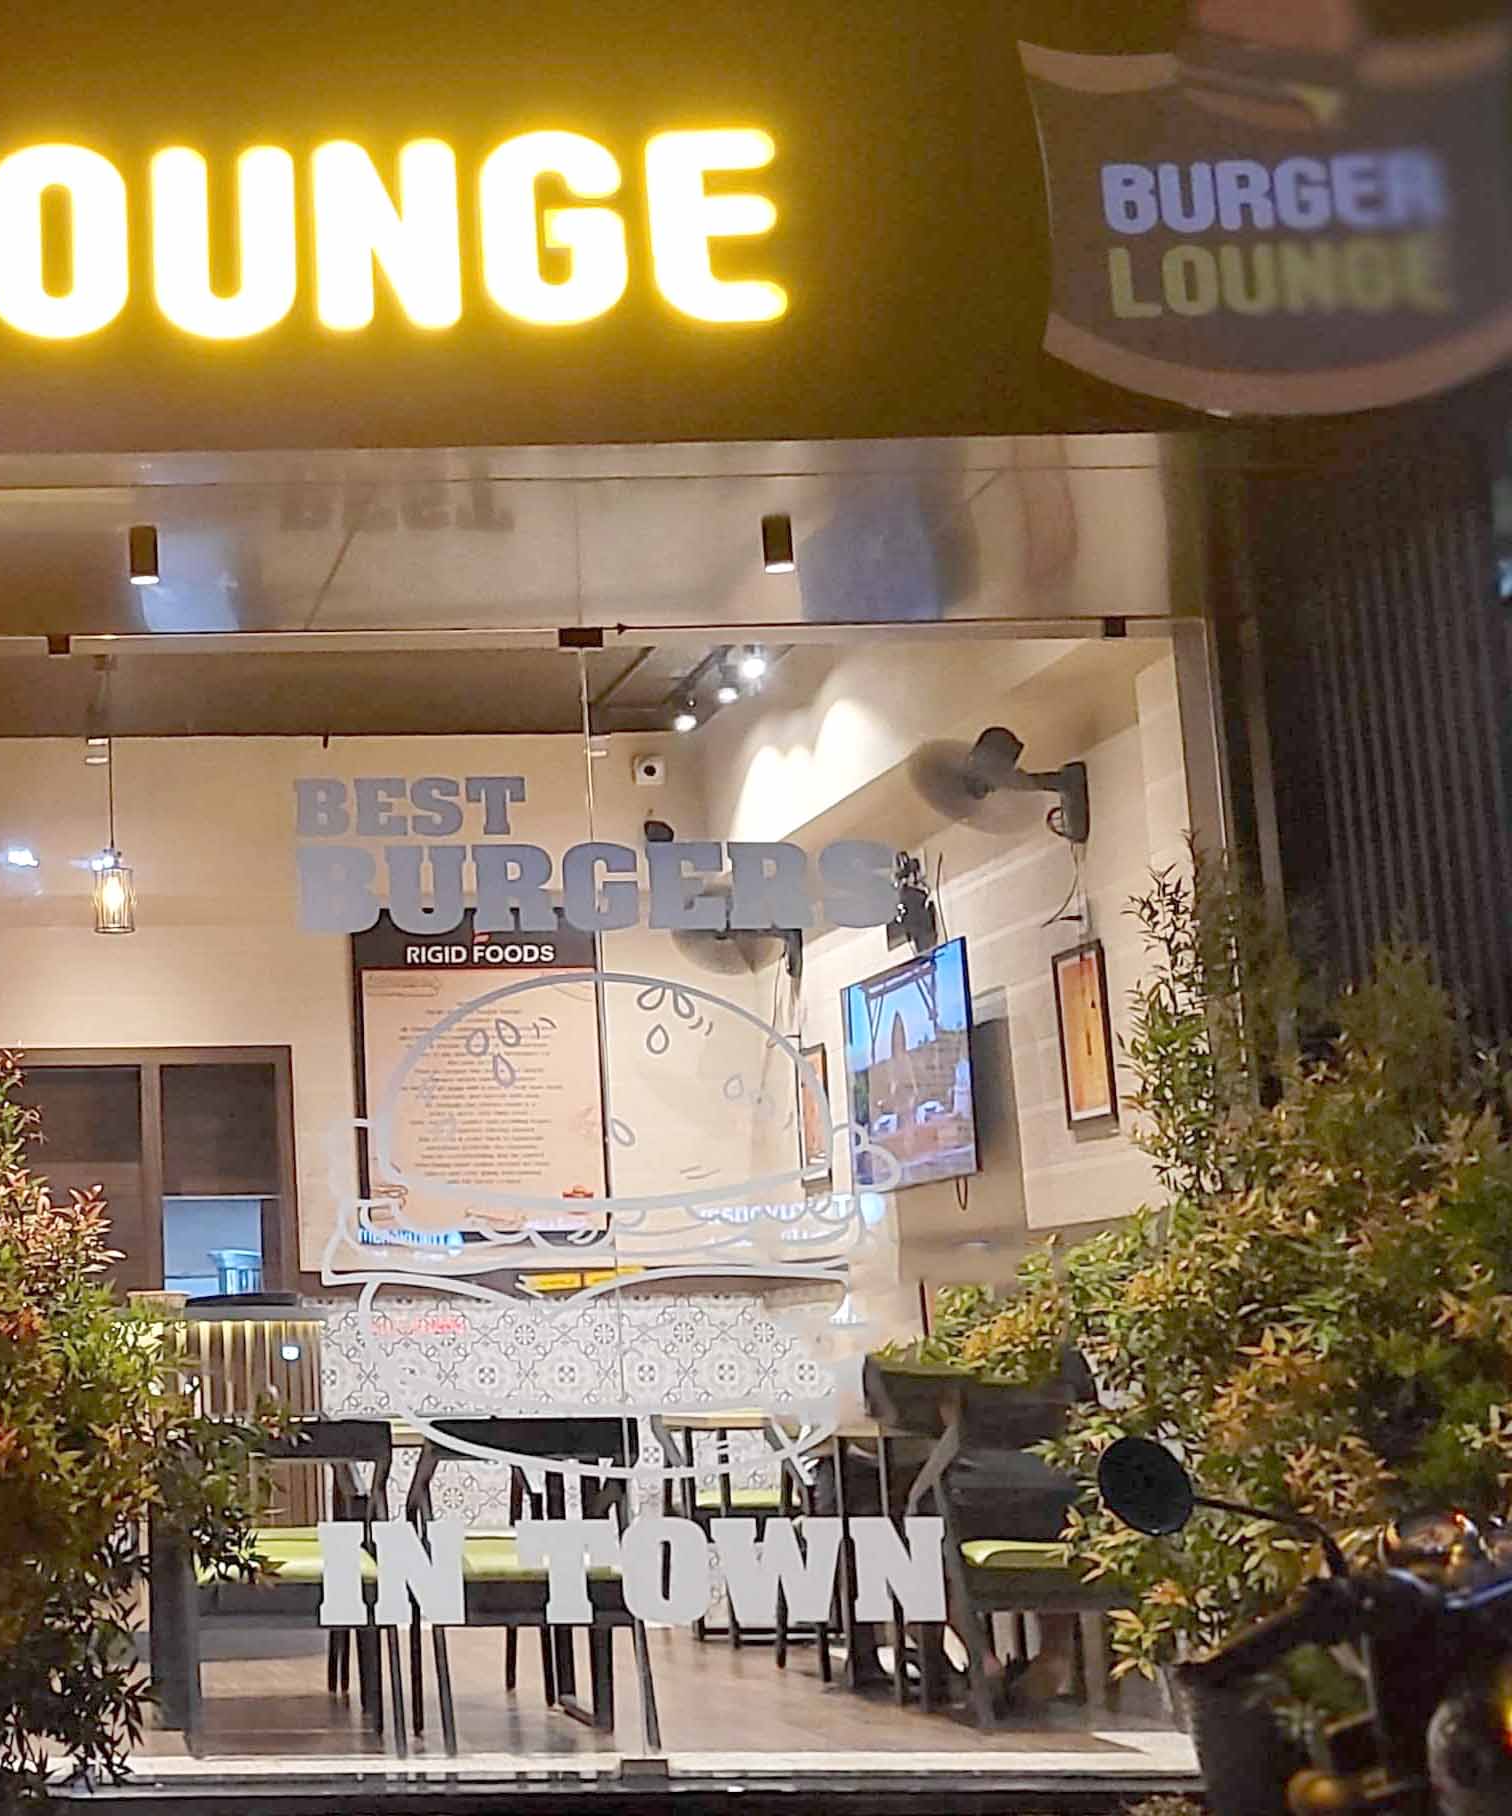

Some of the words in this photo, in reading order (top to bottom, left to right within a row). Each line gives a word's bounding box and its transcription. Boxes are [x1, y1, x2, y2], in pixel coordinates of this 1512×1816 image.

[1101, 147, 1446, 235] BURGER
[294, 776, 526, 836] BEST
[295, 840, 900, 936] BURGERS
[406, 946, 467, 964] RIGID
[473, 945, 555, 963] FOODS
[317, 1518, 466, 1625] IN
[514, 1515, 948, 1624] TOWN
